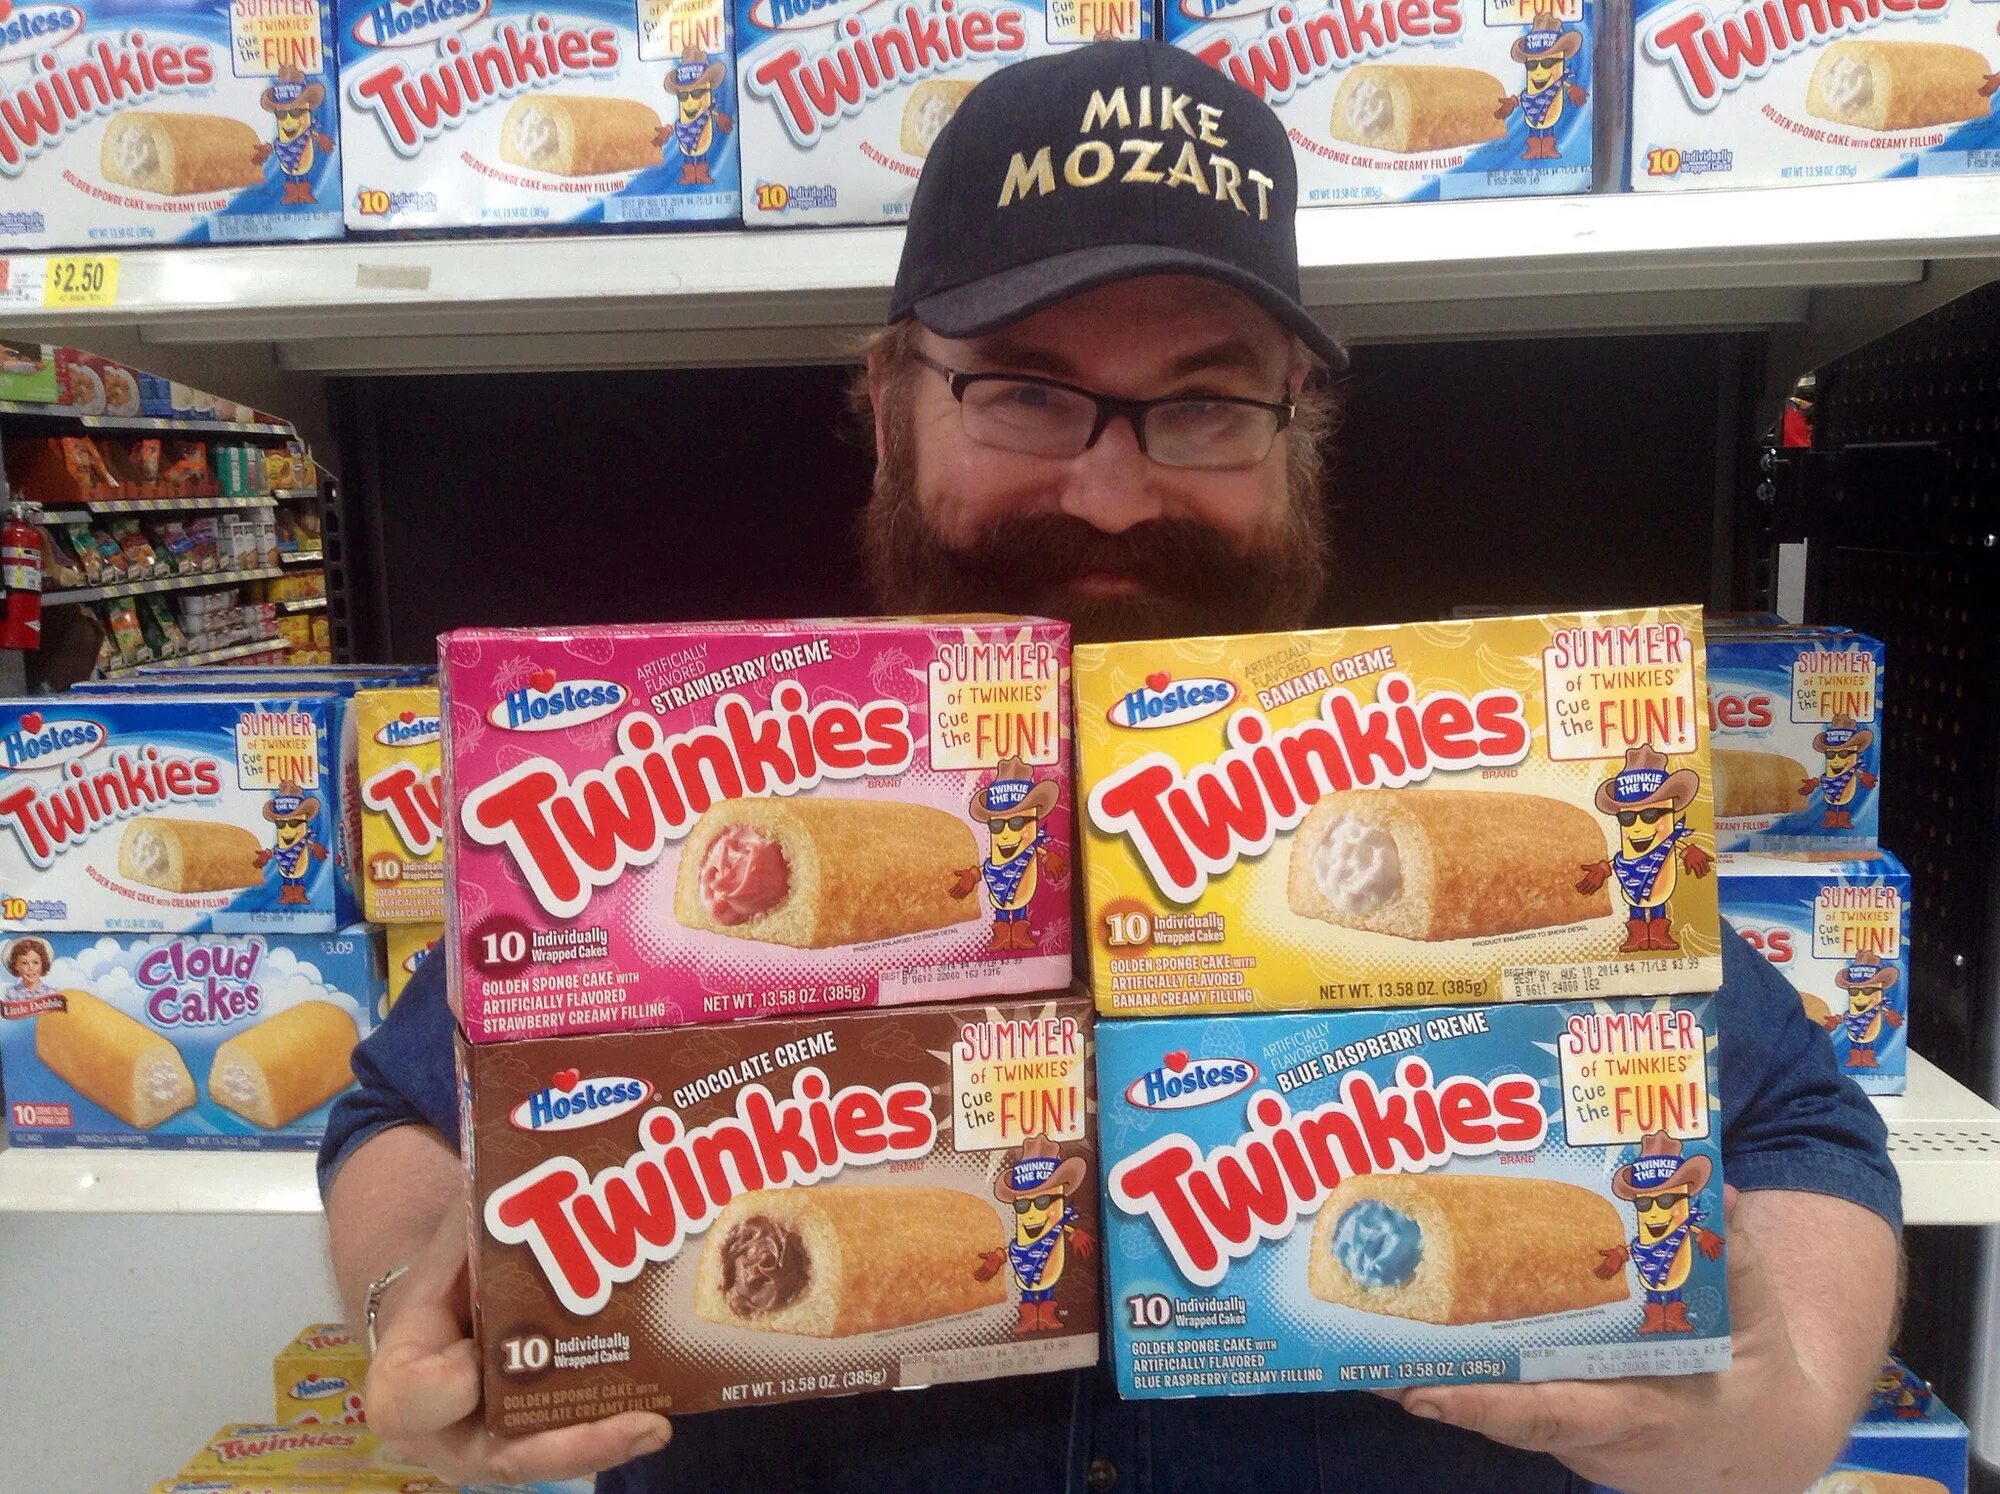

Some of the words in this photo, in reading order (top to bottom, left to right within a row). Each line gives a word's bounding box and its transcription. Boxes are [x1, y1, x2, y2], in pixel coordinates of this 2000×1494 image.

[372, 0, 478, 43] Hostess
[1052, 1, 1075, 14] Cue
[1080, 2, 1137, 36] FUN!
[1055, 14, 1077, 28] the
[668, 16, 720, 53] FUN!
[237, 36, 259, 48] Cue
[264, 36, 318, 68] FUN!
[240, 49, 261, 61] the
[359, 16, 619, 146] Twinkies
[756, 0, 1025, 136] Twinkies
[1080, 85, 1228, 150] MIKE
[1762, 104, 1793, 130] GOLDEN
[1791, 122, 1826, 143] SPONGE
[1827, 132, 1850, 147] CAKE
[1870, 136, 1908, 149] CREAMY
[1910, 133, 1944, 147] FILLING
[859, 141, 890, 168] GOLDEN
[889, 160, 922, 180] SPONGE
[1288, 127, 1318, 155] GOLDEN
[1317, 146, 1351, 167] SPONGE
[1351, 154, 1374, 169] CAKE
[1393, 158, 1429, 171] CREAMY
[1430, 155, 1463, 170] FILLING
[1648, 149, 1680, 176] 10
[1681, 150, 1733, 165] Individually
[997, 139, 1274, 222] MOZART
[163, 199, 194, 212] CREAMY
[197, 198, 228, 211] FILLING
[358, 191, 390, 216] 10
[757, 186, 787, 212] 10
[54, 262, 104, 292] $2.50
[1243, 643, 1314, 678] ARTIFICIALLY
[1554, 624, 1685, 669] SUMMER
[636, 642, 708, 681] ARTIFICIALLY
[938, 644, 1053, 683] SUMMER
[1799, 651, 1871, 674] SUMMER
[645, 661, 706, 693] FLAVORED
[651, 653, 767, 716] STRAWBERRY
[771, 638, 833, 674] CREME
[1257, 667, 1329, 713] BANANA
[1331, 645, 1397, 684] CREME
[1566, 674, 1582, 692] of
[506, 683, 621, 728] Hostess
[947, 690, 962, 706] of
[1125, 682, 1231, 726] Hostess
[1797, 689, 1817, 700] Cue
[1820, 690, 1870, 718] FUN!
[1798, 699, 1818, 711] the
[240, 712, 312, 738] SUMMER
[938, 712, 969, 729] Cue
[976, 711, 1051, 760] FUN!
[1556, 698, 1591, 717] Cue
[1599, 696, 1687, 748] FUN!
[1560, 718, 1594, 738] the
[2, 722, 98, 768] Hostess
[247, 740, 258, 749] of
[941, 729, 971, 749] the
[242, 754, 262, 765] Cue
[266, 755, 314, 784] FUN!
[244, 764, 264, 777] the
[1482, 769, 1518, 780] BRAND
[1617, 772, 1662, 787] TWINKIE
[476, 687, 910, 902] Twinkies
[867, 780, 901, 790] BRAND
[989, 783, 1029, 797] TWINKIE
[1101, 679, 1525, 888] Twinkies
[0, 747, 221, 859] Twinkies
[1742, 820, 1770, 831] FILLING
[372, 861, 400, 881] 10
[3, 898, 28, 921] 10
[1820, 886, 1897, 909] SUMMER
[1107, 914, 1149, 946] 10
[1154, 913, 1225, 931] Individually
[1825, 912, 1837, 922] of
[319, 940, 355, 956] $3.09
[481, 930, 527, 965] 10
[532, 927, 608, 948] Individually
[1472, 938, 1501, 948] PRODUCT
[1503, 933, 1536, 943] ENLARGED
[1818, 924, 1839, 935] Cue
[1843, 926, 1895, 954] FUN!
[1820, 935, 1840, 946] the
[138, 940, 260, 988] Cloud
[531, 949, 577, 964] Wrapped
[578, 944, 608, 958] Cakes
[1111, 957, 1153, 974] GOLDEN
[1155, 956, 1199, 972] SPONGE
[1201, 955, 1232, 971] CAKE
[482, 978, 529, 996] GOLDEN
[532, 974, 580, 992] SPONGE
[582, 972, 614, 988] CAKE
[1561, 968, 1577, 981] AUG
[1598, 964, 1620, 977] 2014
[148, 978, 261, 1026] Cakes
[483, 994, 565, 1015] ARTIFICIALLY
[567, 989, 627, 1007] FLAVORED
[761, 988, 796, 1007] 13.58
[822, 983, 867, 1004] (385g)
[1112, 992, 1159, 1009] BANANA
[1161, 990, 1207, 1006] CREAMY
[1209, 988, 1253, 1005] FILLING
[1320, 984, 1343, 1000] NET
[1348, 982, 1374, 999] WT.
[1377, 982, 1413, 998] 13.58
[1442, 979, 1488, 998] (385g)
[483, 1013, 565, 1034] STRAWBERRY
[569, 1008, 618, 1025] CREAMY
[621, 1002, 666, 1020] FILLING
[961, 1017, 1077, 1062] SUMMER
[1568, 1011, 1696, 1056] SUMMER
[1271, 1039, 1329, 1072] FLAVORED
[1276, 1058, 1325, 1095] BLUE
[1325, 1023, 1423, 1075] RASPBERRY
[1426, 1010, 1490, 1042] CREME
[673, 1050, 773, 1110] CHOCOLATE
[776, 1030, 837, 1068] CREME
[970, 1069, 986, 1085] of
[1581, 1061, 1597, 1078] of
[1145, 1062, 1249, 1106] Hostess
[15, 1104, 37, 1127] 10
[528, 1079, 642, 1128] Hostess
[961, 1091, 992, 1109] Cue
[1001, 1087, 1078, 1138] FUN!
[1572, 1084, 1606, 1103] Cue
[1614, 1082, 1699, 1135] FUN!
[1576, 1103, 1610, 1123] the
[965, 1110, 995, 1129] the
[1121, 1063, 1542, 1271] Twinkies
[498, 1074, 932, 1299] Twinkies
[1129, 1296, 1171, 1327] 10
[1176, 1297, 1246, 1315] Individually
[505, 1338, 549, 1372] 10
[555, 1332, 630, 1352] Individually
[1133, 1356, 1206, 1373] ARTIFICIALLY
[1164, 1371, 1230, 1388] RASPBERRY
[1231, 1369, 1277, 1386] CREAMY
[1280, 1367, 1323, 1384] FILLING
[1398, 1362, 1434, 1379] 13.58
[1461, 1359, 1507, 1378] (385g)
[781, 1377, 816, 1394] 13.58
[842, 1370, 887, 1389] (385g)
[214, 1432, 357, 1461] Twinkies
